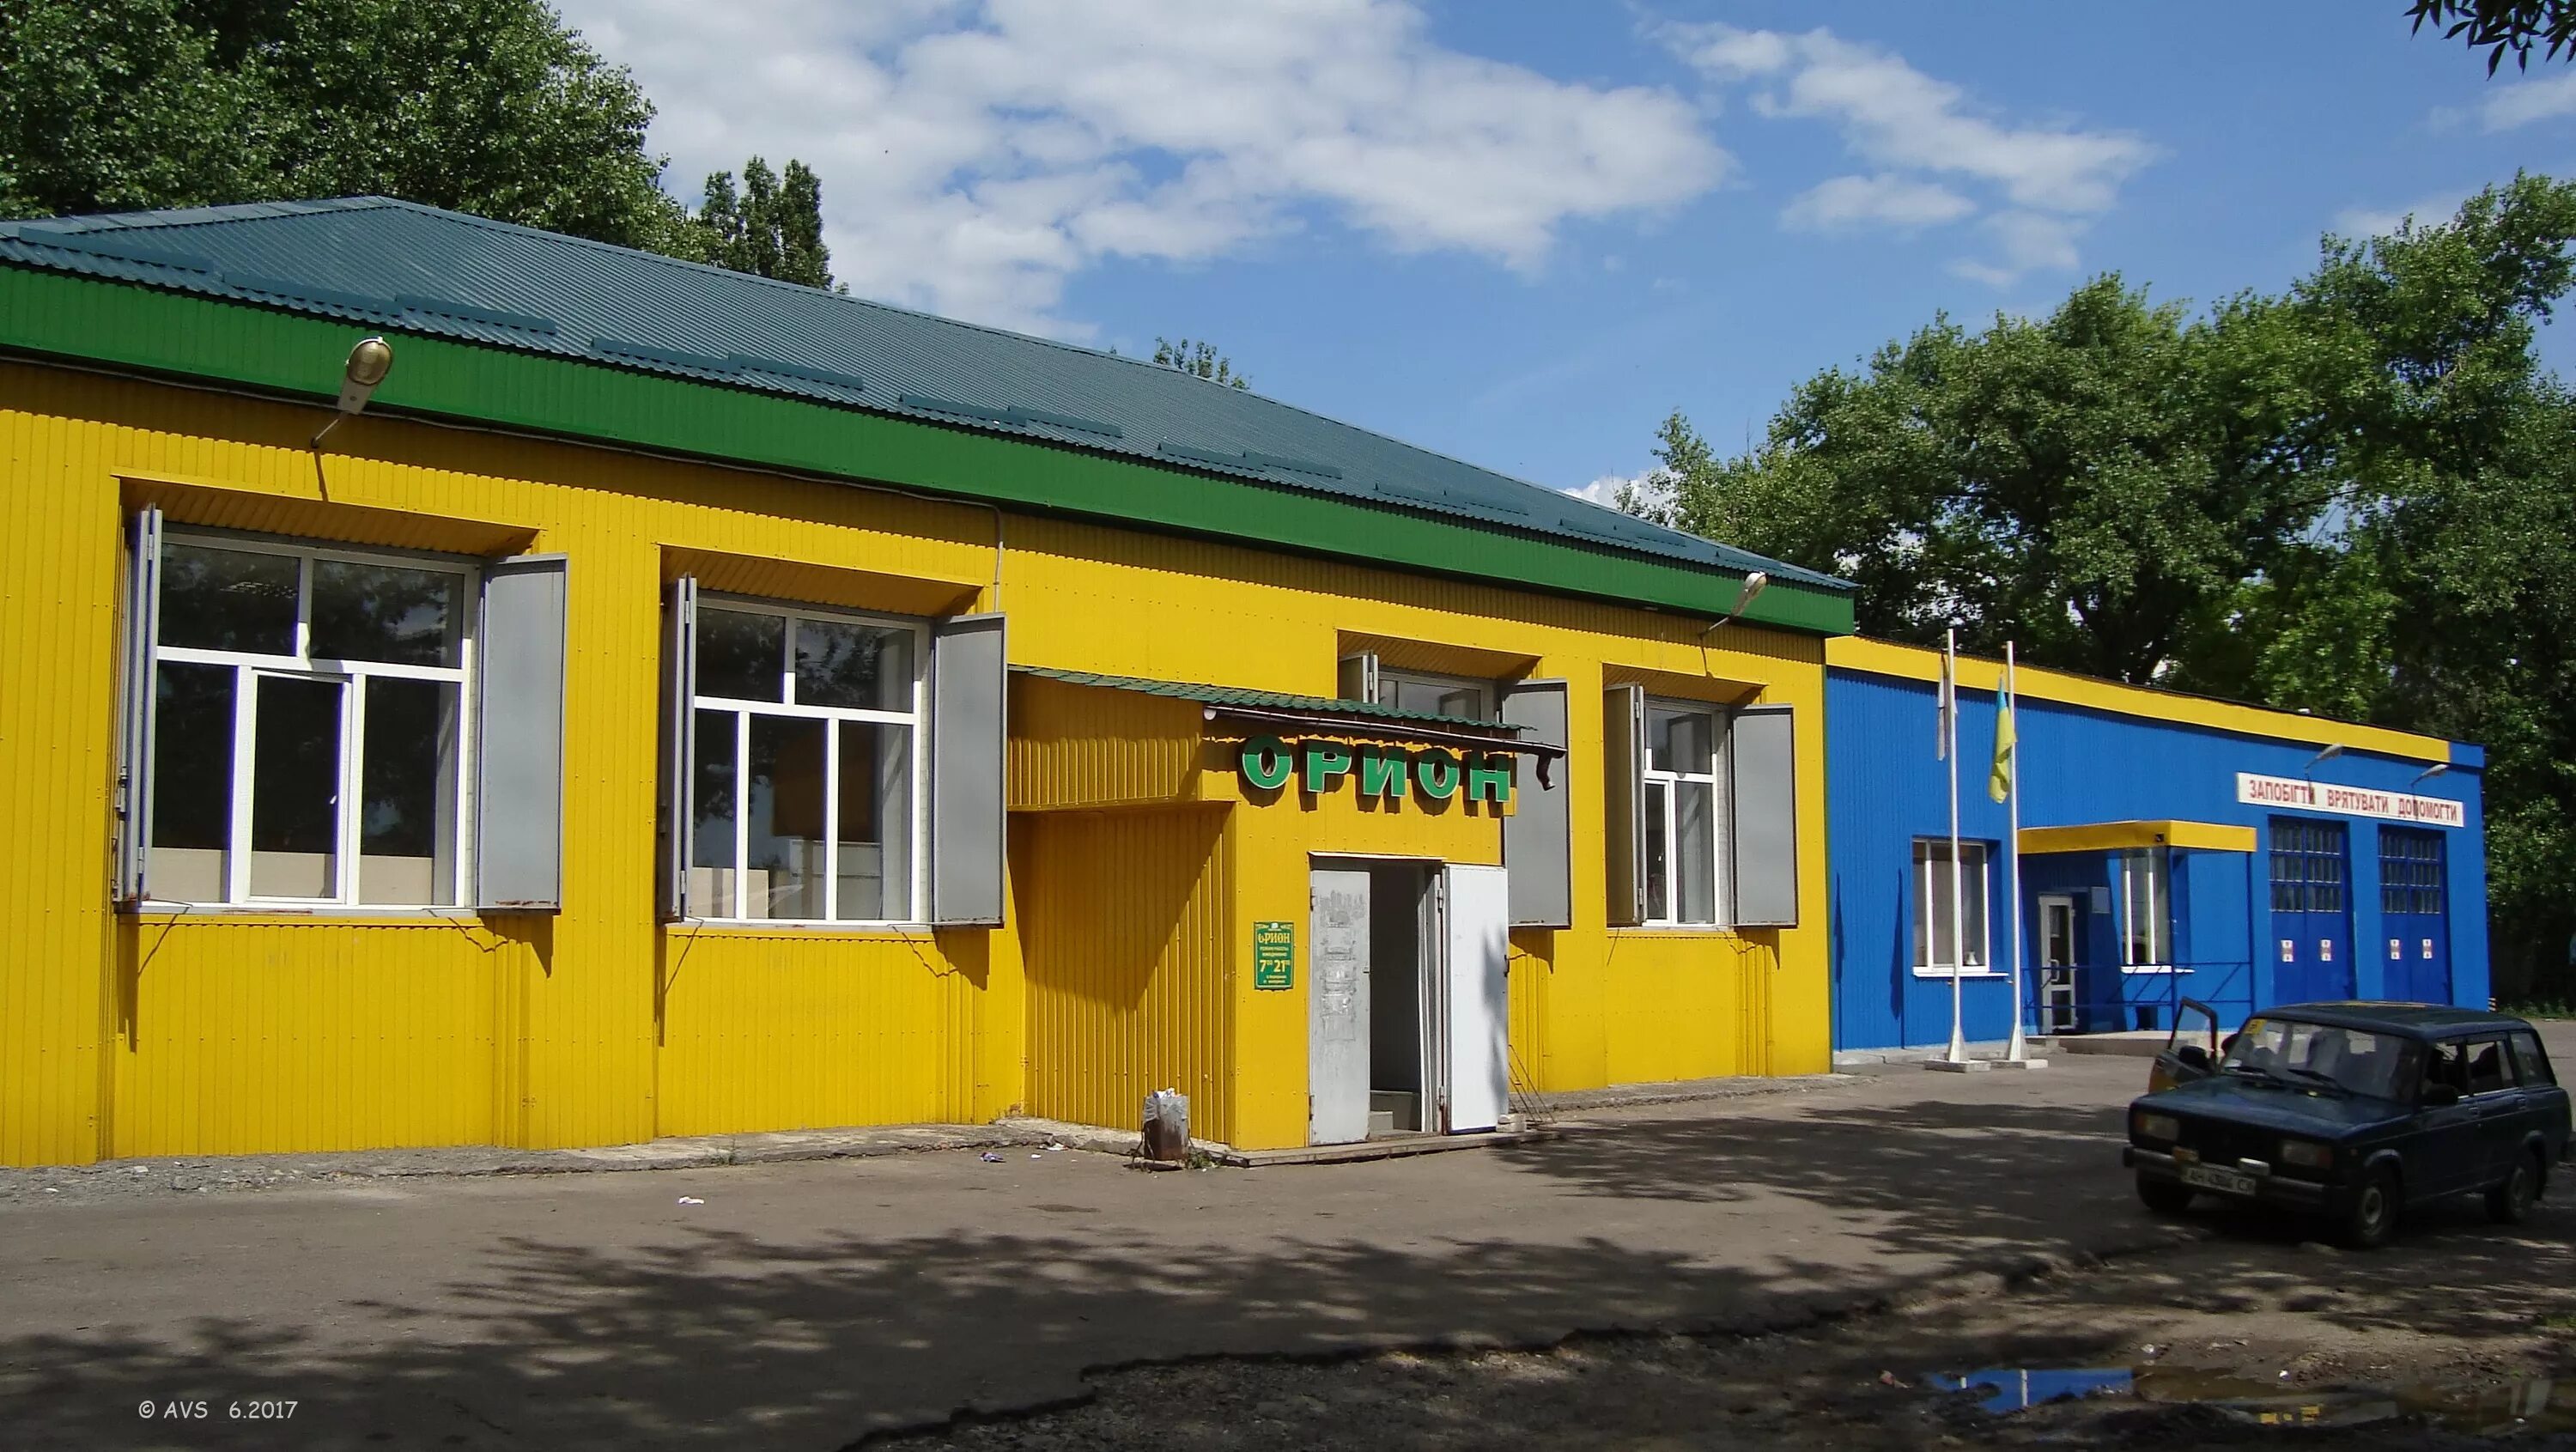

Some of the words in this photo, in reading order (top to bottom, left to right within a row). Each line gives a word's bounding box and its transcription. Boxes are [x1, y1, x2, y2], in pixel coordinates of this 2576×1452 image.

[1242, 734, 1511, 802] ОРИОН
[2249, 779, 2316, 805] ЗАПОБІГТИ
[2327, 788, 2389, 814] ВРЯТУВАТИ
[2398, 798, 2458, 822] ДОПОМОГТИ
